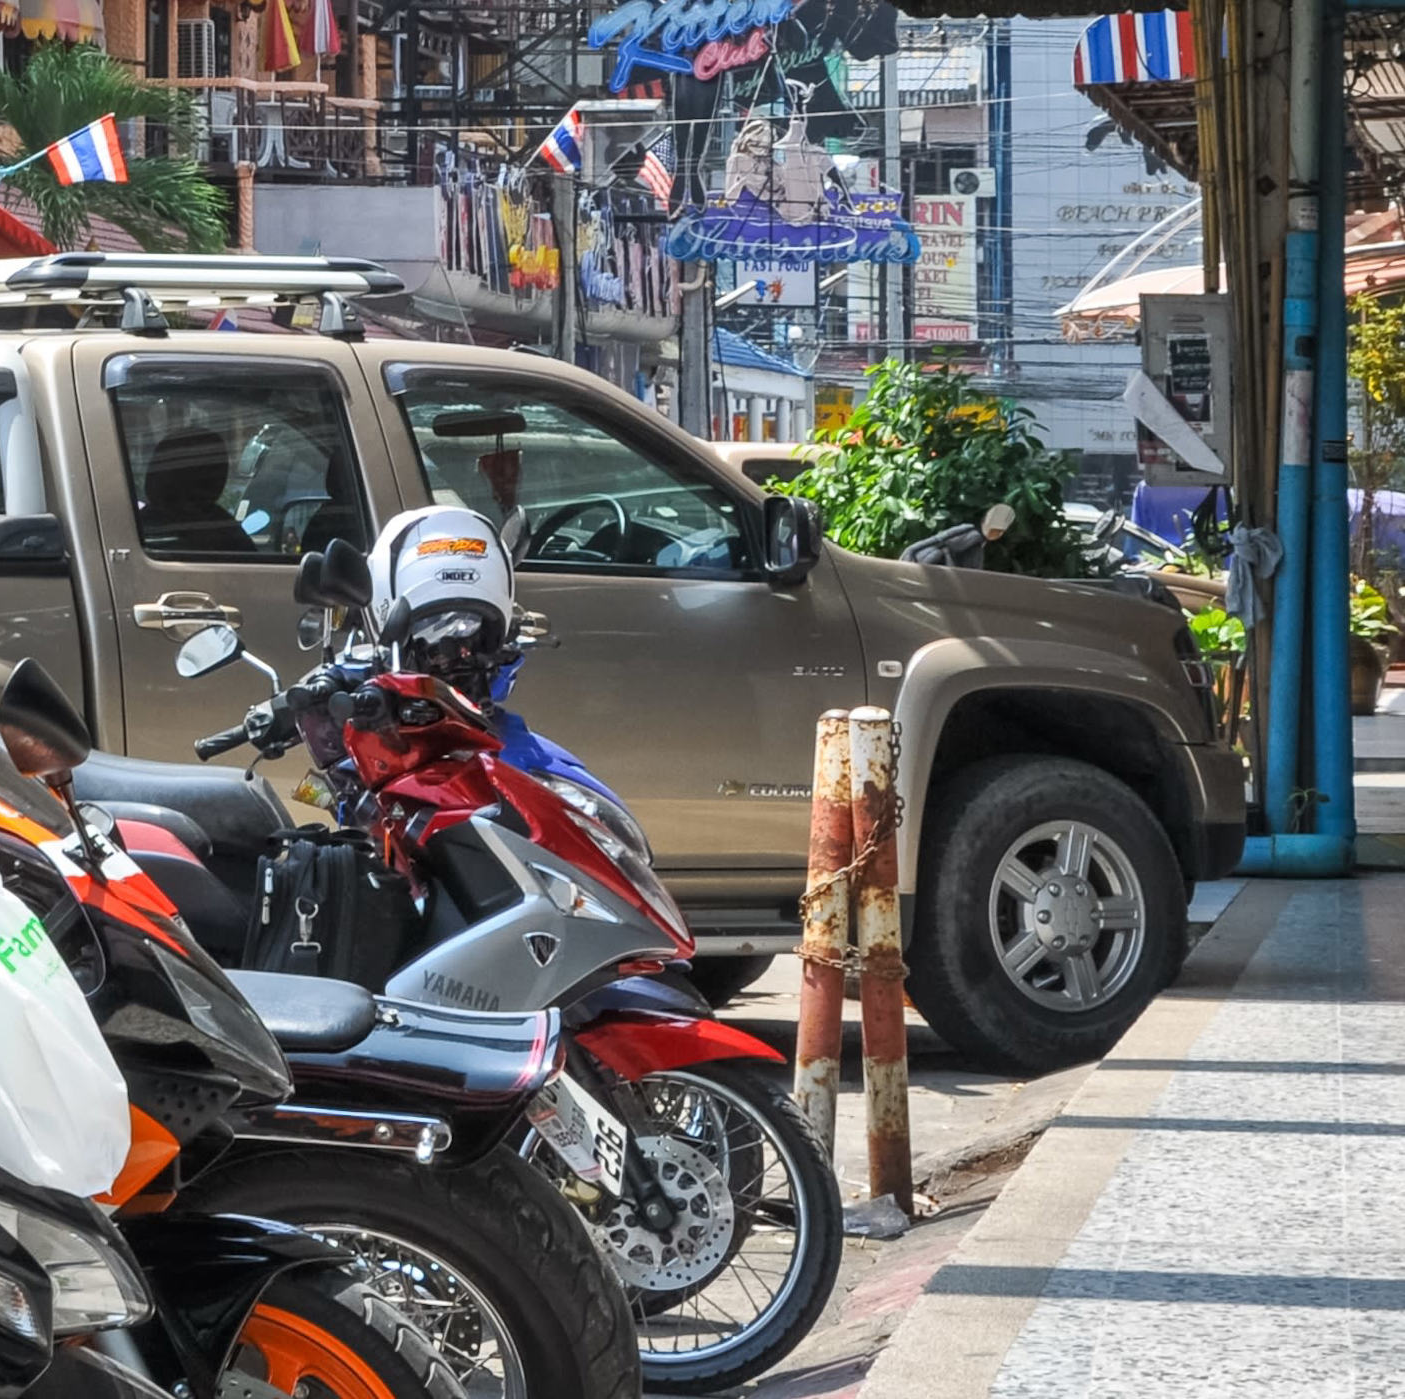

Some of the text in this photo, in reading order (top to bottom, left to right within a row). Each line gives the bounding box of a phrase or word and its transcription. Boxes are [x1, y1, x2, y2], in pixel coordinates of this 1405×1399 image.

[694, 27, 769, 81] Club
[921, 234, 965, 248] RAVEL
[422, 970, 501, 1012] YAMAHA
